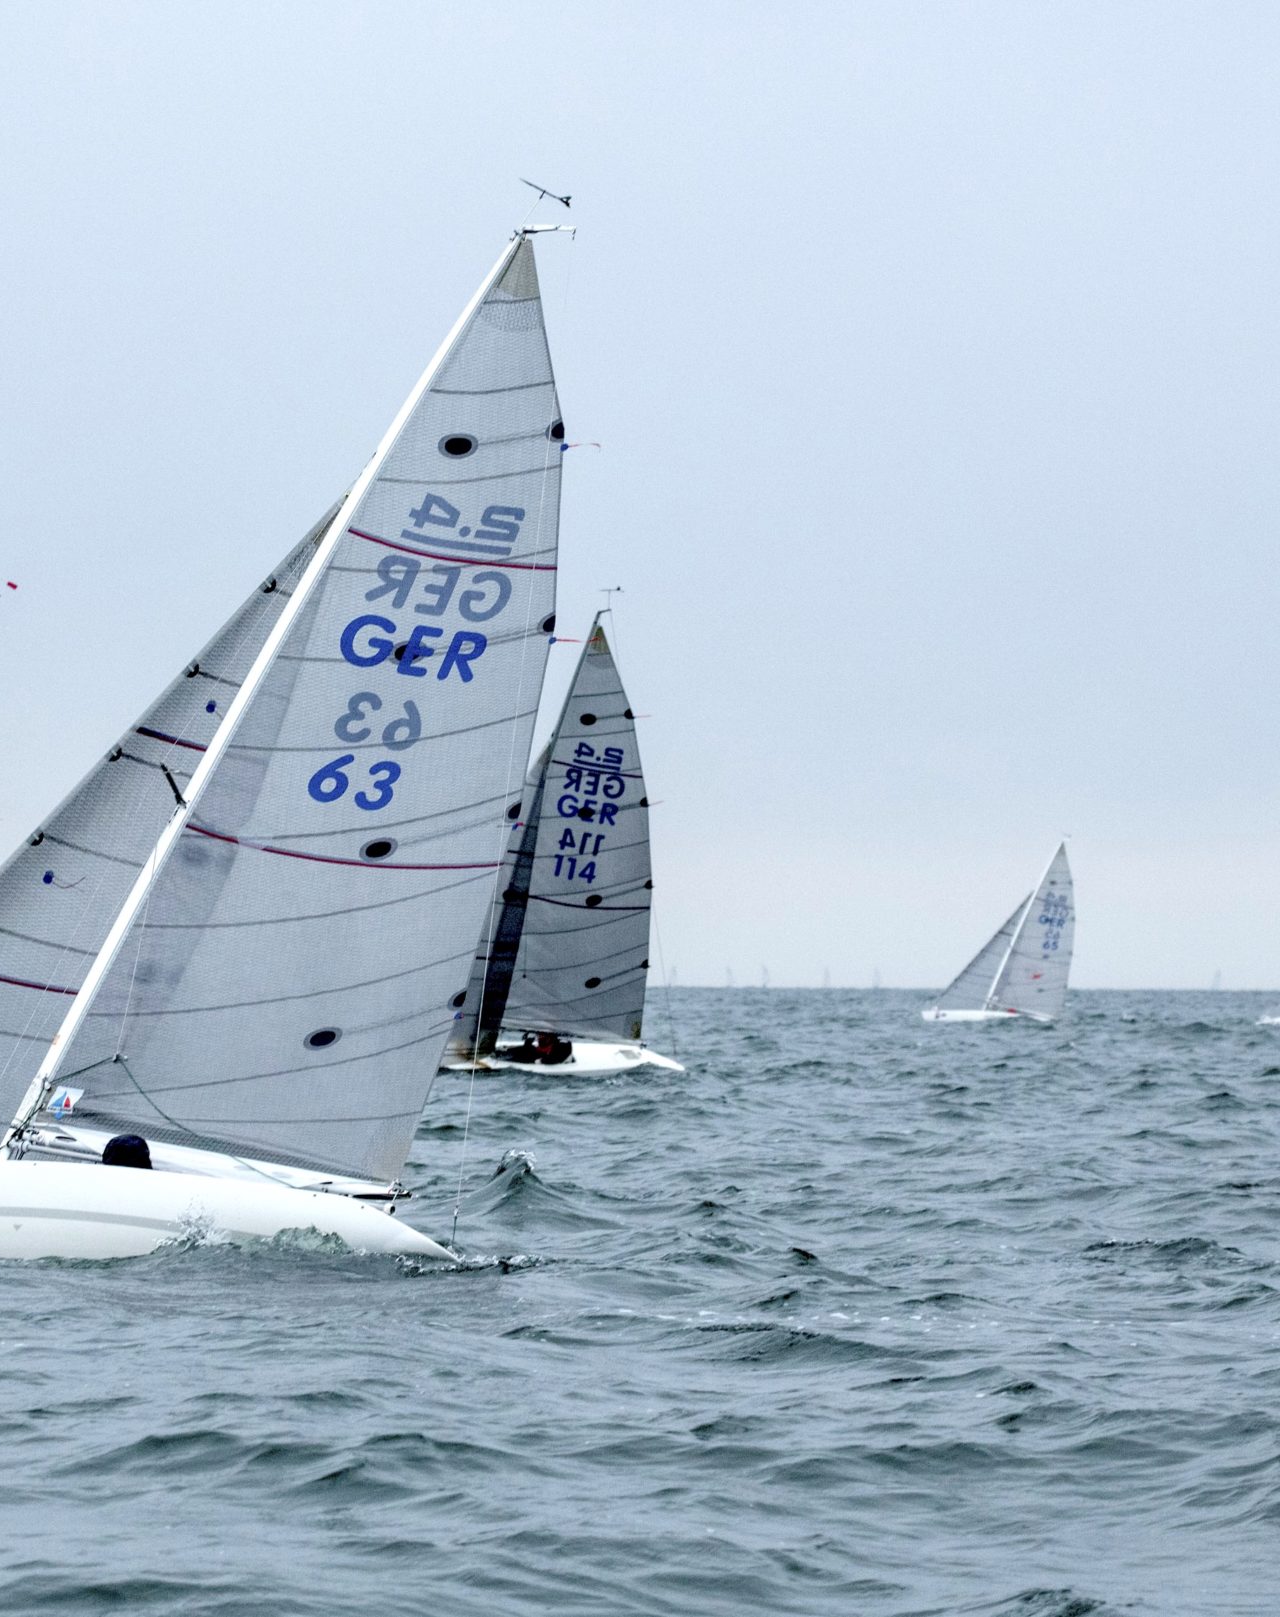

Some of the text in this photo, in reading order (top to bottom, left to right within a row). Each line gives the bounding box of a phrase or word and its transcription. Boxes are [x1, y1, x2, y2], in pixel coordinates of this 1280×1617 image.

[340, 615, 487, 682] GER
[308, 754, 401, 810] 63
[557, 795, 619, 826] GER
[554, 854, 597, 884] 114
